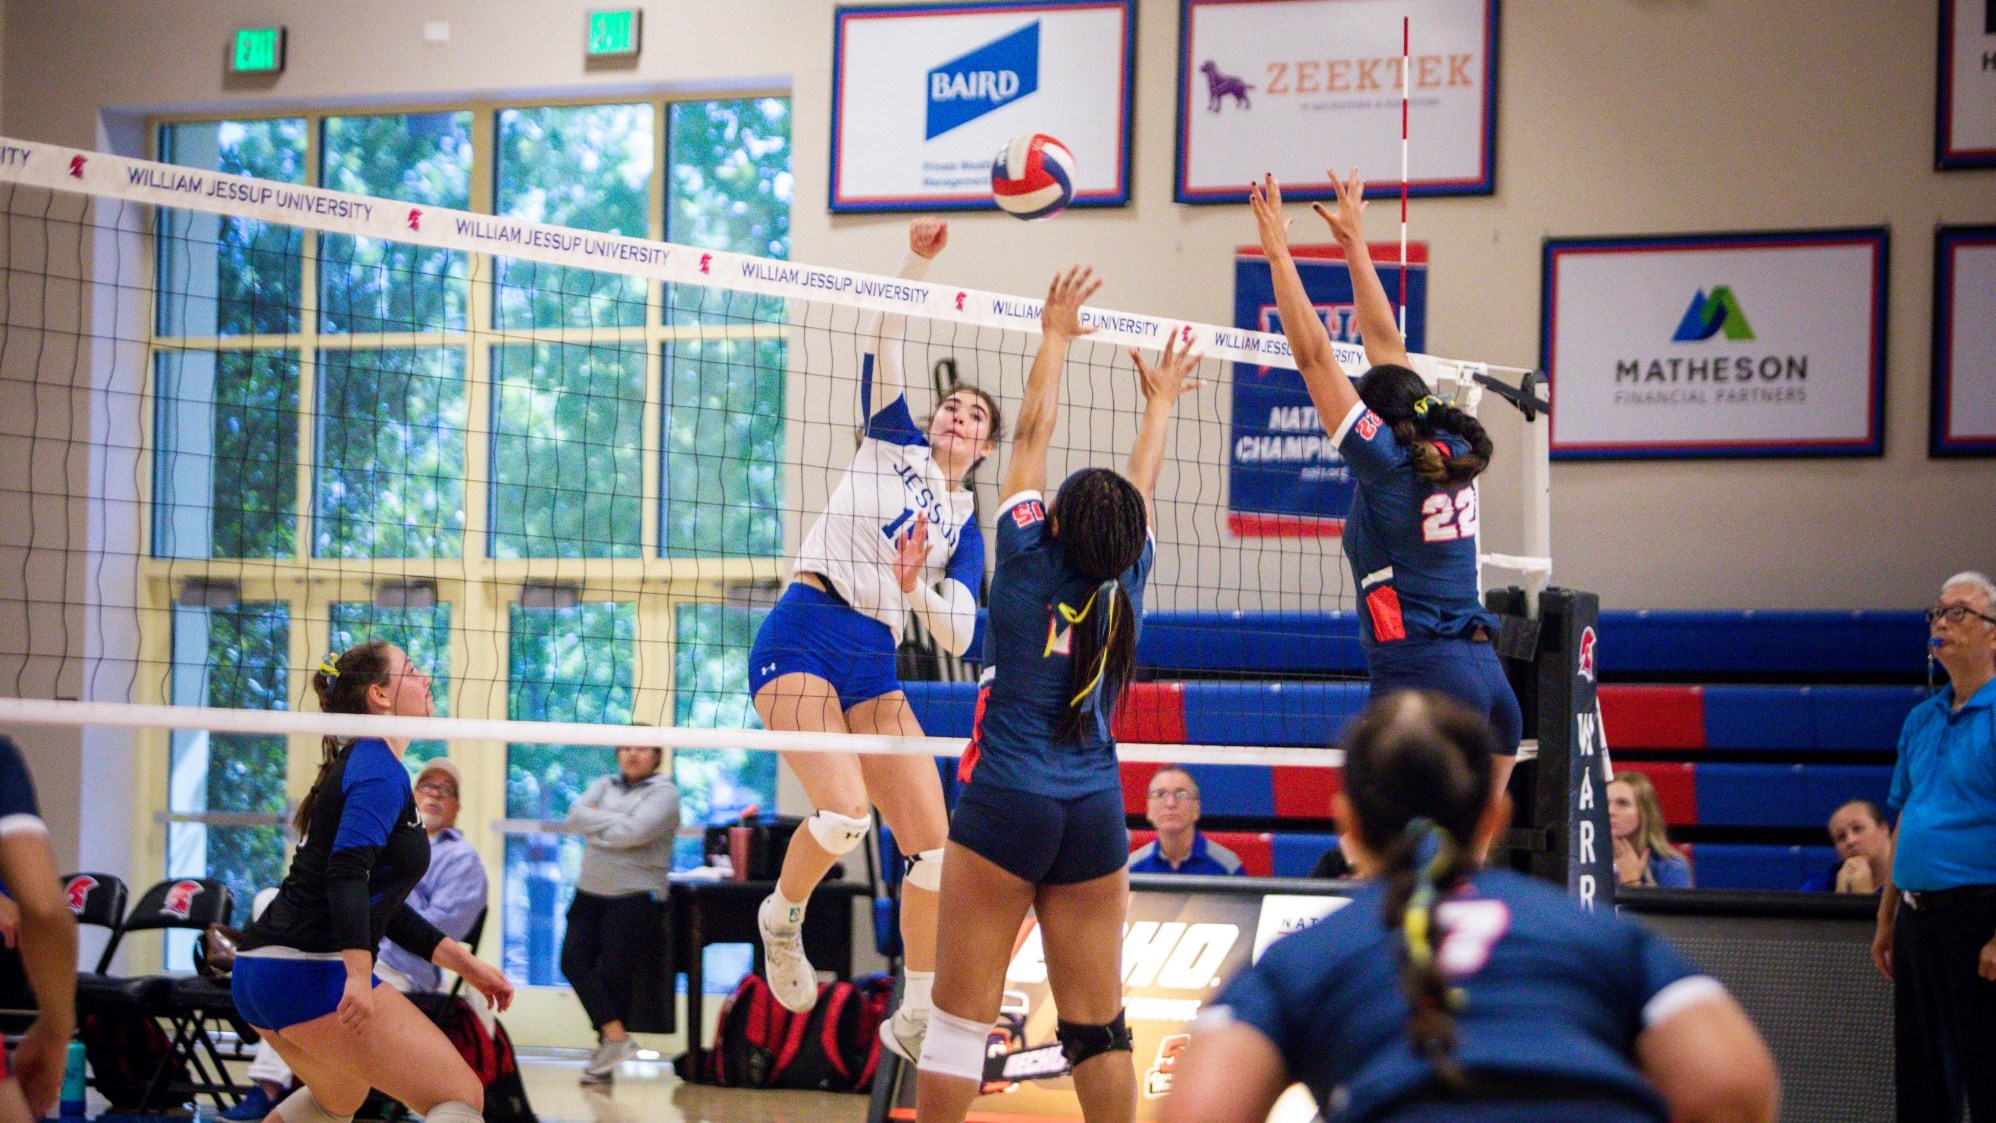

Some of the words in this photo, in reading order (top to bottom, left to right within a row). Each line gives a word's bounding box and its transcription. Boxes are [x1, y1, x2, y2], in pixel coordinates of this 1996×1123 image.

[931, 70, 1020, 105] BAIRD
[1265, 53, 1474, 96] ZEEKTEK
[0, 145, 31, 167] ITY
[128, 165, 203, 194] WILLIAM
[206, 179, 272, 205] JESSUP
[276, 190, 374, 222] UNIVERSITY
[455, 217, 522, 244] WILLIAM
[525, 229, 582, 252] JESSUP
[585, 239, 670, 266] UNIVERSITY
[741, 261, 800, 285] WILLIAM
[801, 272, 853, 292] JESSUP
[856, 279, 930, 304] UNIVERSITY
[1092, 314, 1160, 337] UNIVERSITY
[1214, 332, 1260, 351] WILLIAM
[1262, 339, 1294, 357] JESSU
[1615, 355, 1808, 383] MATHESON
[1614, 386, 1707, 403] FINANCIAL
[1716, 385, 1807, 402] PARTNERS
[1421, 485, 1476, 542] 22
